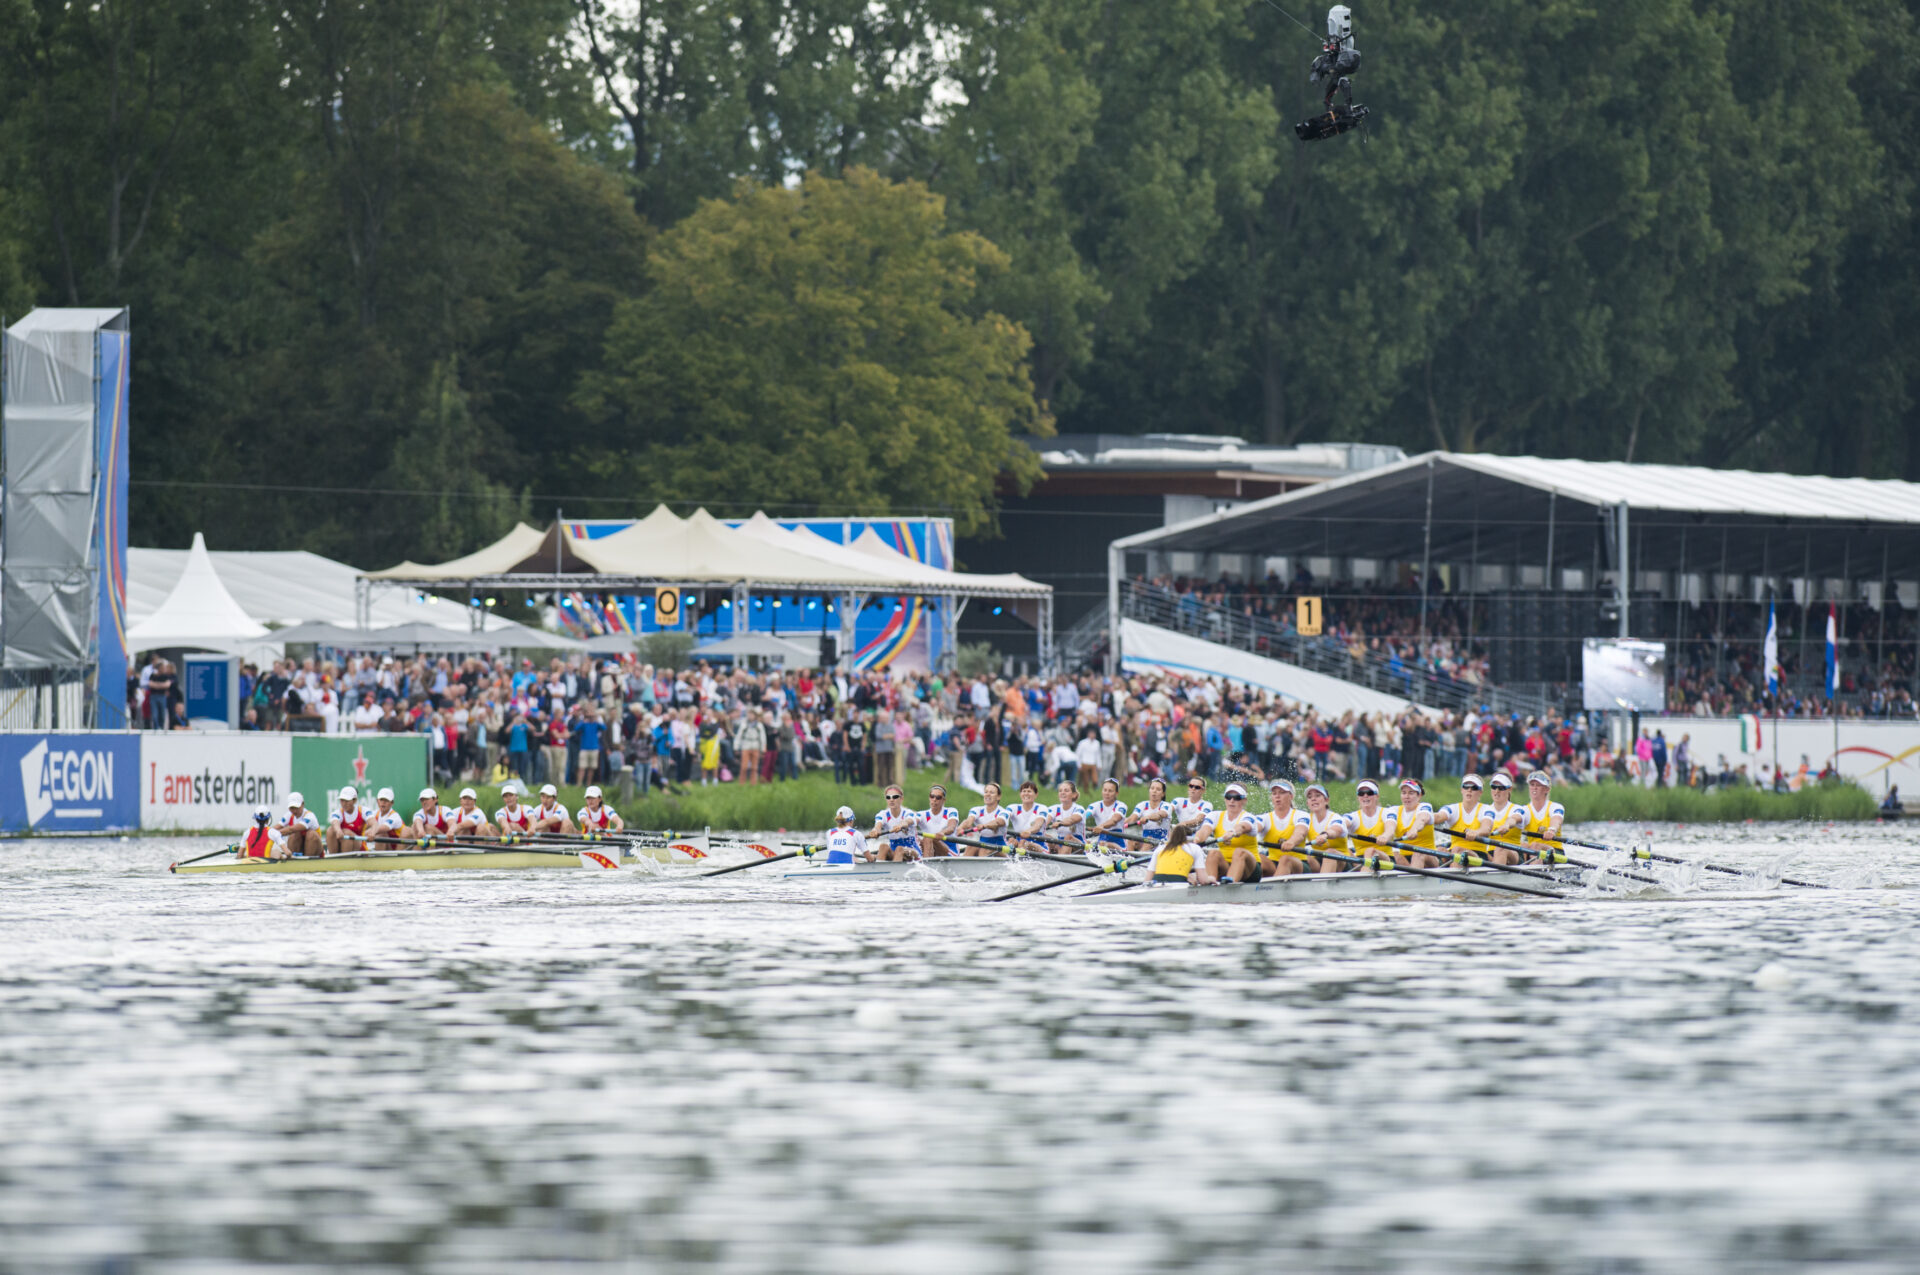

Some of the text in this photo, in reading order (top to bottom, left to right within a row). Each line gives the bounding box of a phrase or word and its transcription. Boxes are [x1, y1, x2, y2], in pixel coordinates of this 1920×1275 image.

[1304, 599, 1312, 625] 1
[40, 750, 114, 801] AEGON
[150, 761, 157, 804] I
[833, 838, 847, 846] RUS
